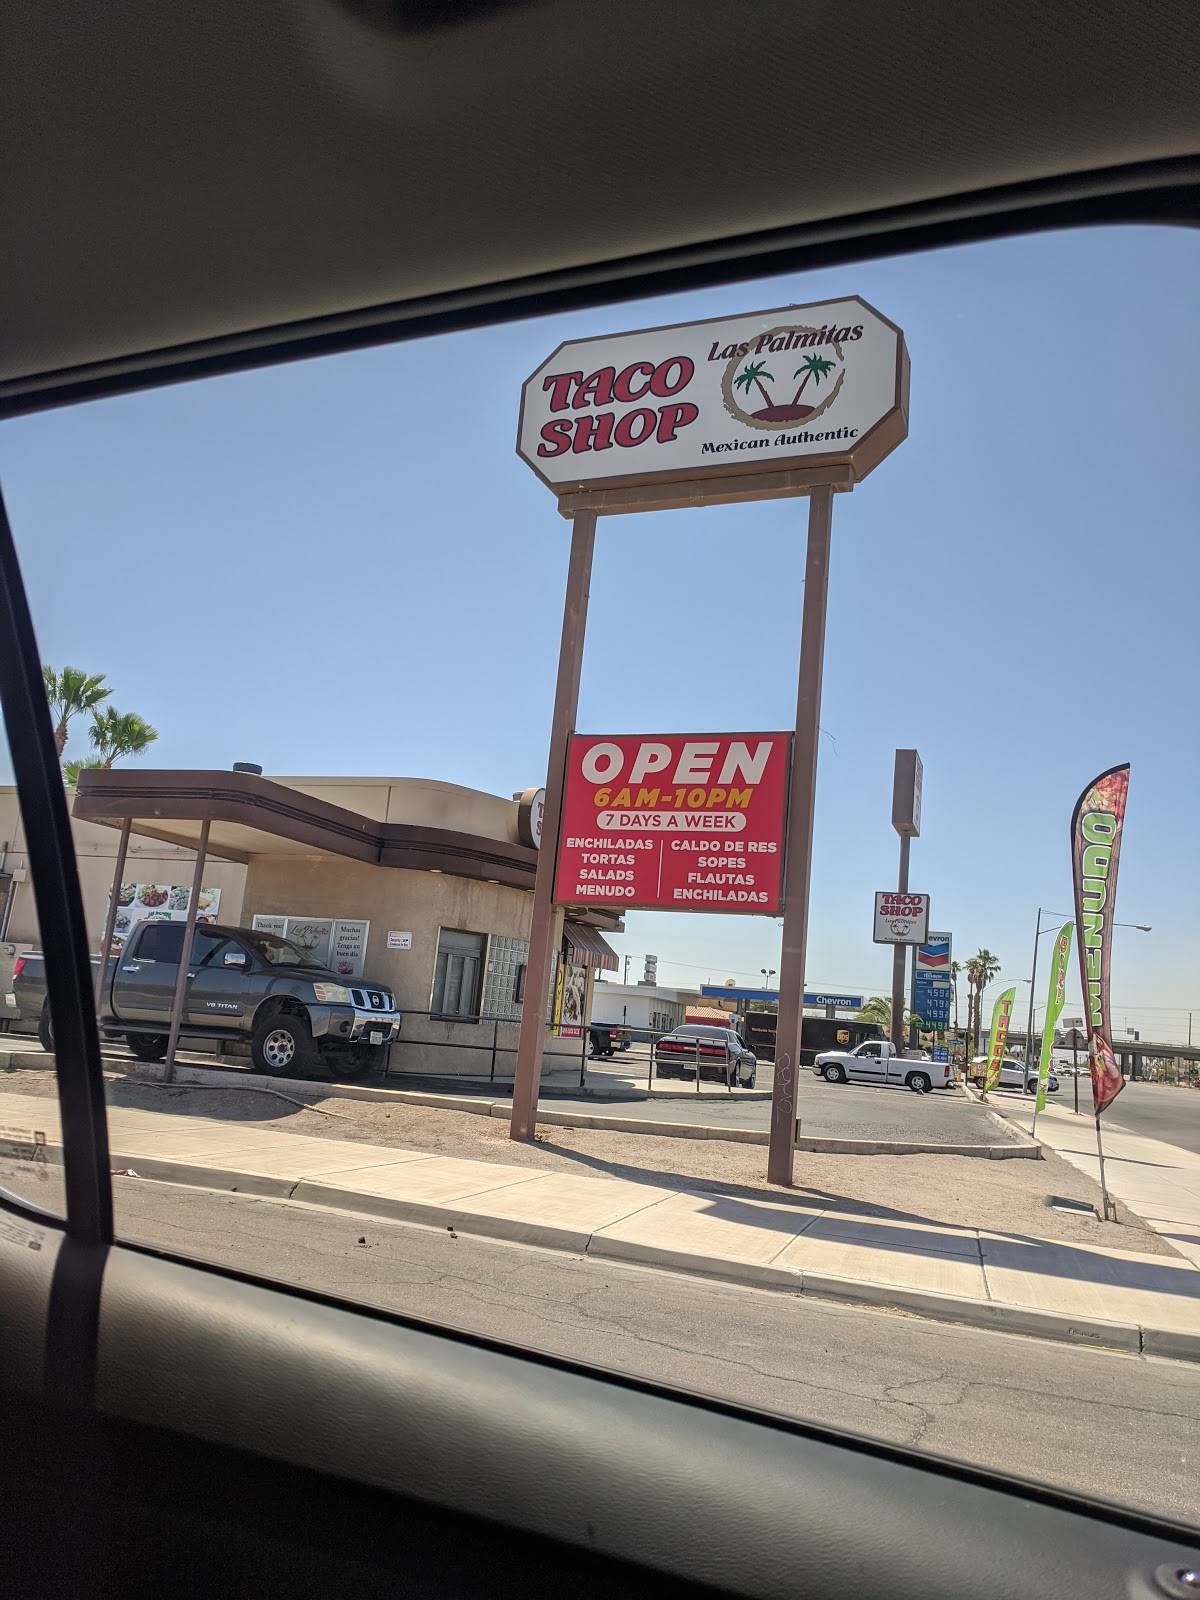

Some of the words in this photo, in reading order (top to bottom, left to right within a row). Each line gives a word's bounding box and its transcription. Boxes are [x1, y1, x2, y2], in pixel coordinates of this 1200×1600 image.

[708, 341, 749, 362] Las
[755, 324, 864, 355] Palmitas
[543, 356, 695, 413] TACO
[536, 402, 699, 458] SHOP
[701, 437, 770, 455] Mexican
[774, 426, 859, 447] Authentic
[581, 741, 773, 785] OPEN
[593, 787, 753, 809] 6AM-10PM
[606, 814, 614, 826] 7
[619, 814, 661, 827] DAYS
[667, 815, 679, 828] A
[685, 815, 736, 829] WEEK
[566, 837, 654, 850] ENCHILADAS
[671, 839, 721, 852] CALDO
[724, 841, 745, 853] DE
[748, 841, 777, 853] RES
[581, 853, 635, 865] TORTAS
[698, 856, 746, 868] SOPES
[579, 869, 634, 881] SALADS
[688, 872, 755, 885] FLAUTAS
[575, 884, 635, 897] MENUDO
[673, 888, 769, 903] ENCHILADAS
[882, 894, 922, 905] TACO
[879, 905, 923, 917] SHOP
[1081, 812, 1117, 1027] MENUDO
[816, 995, 852, 1006] Chevron
[989, 1000, 1012, 1073] TACOS
